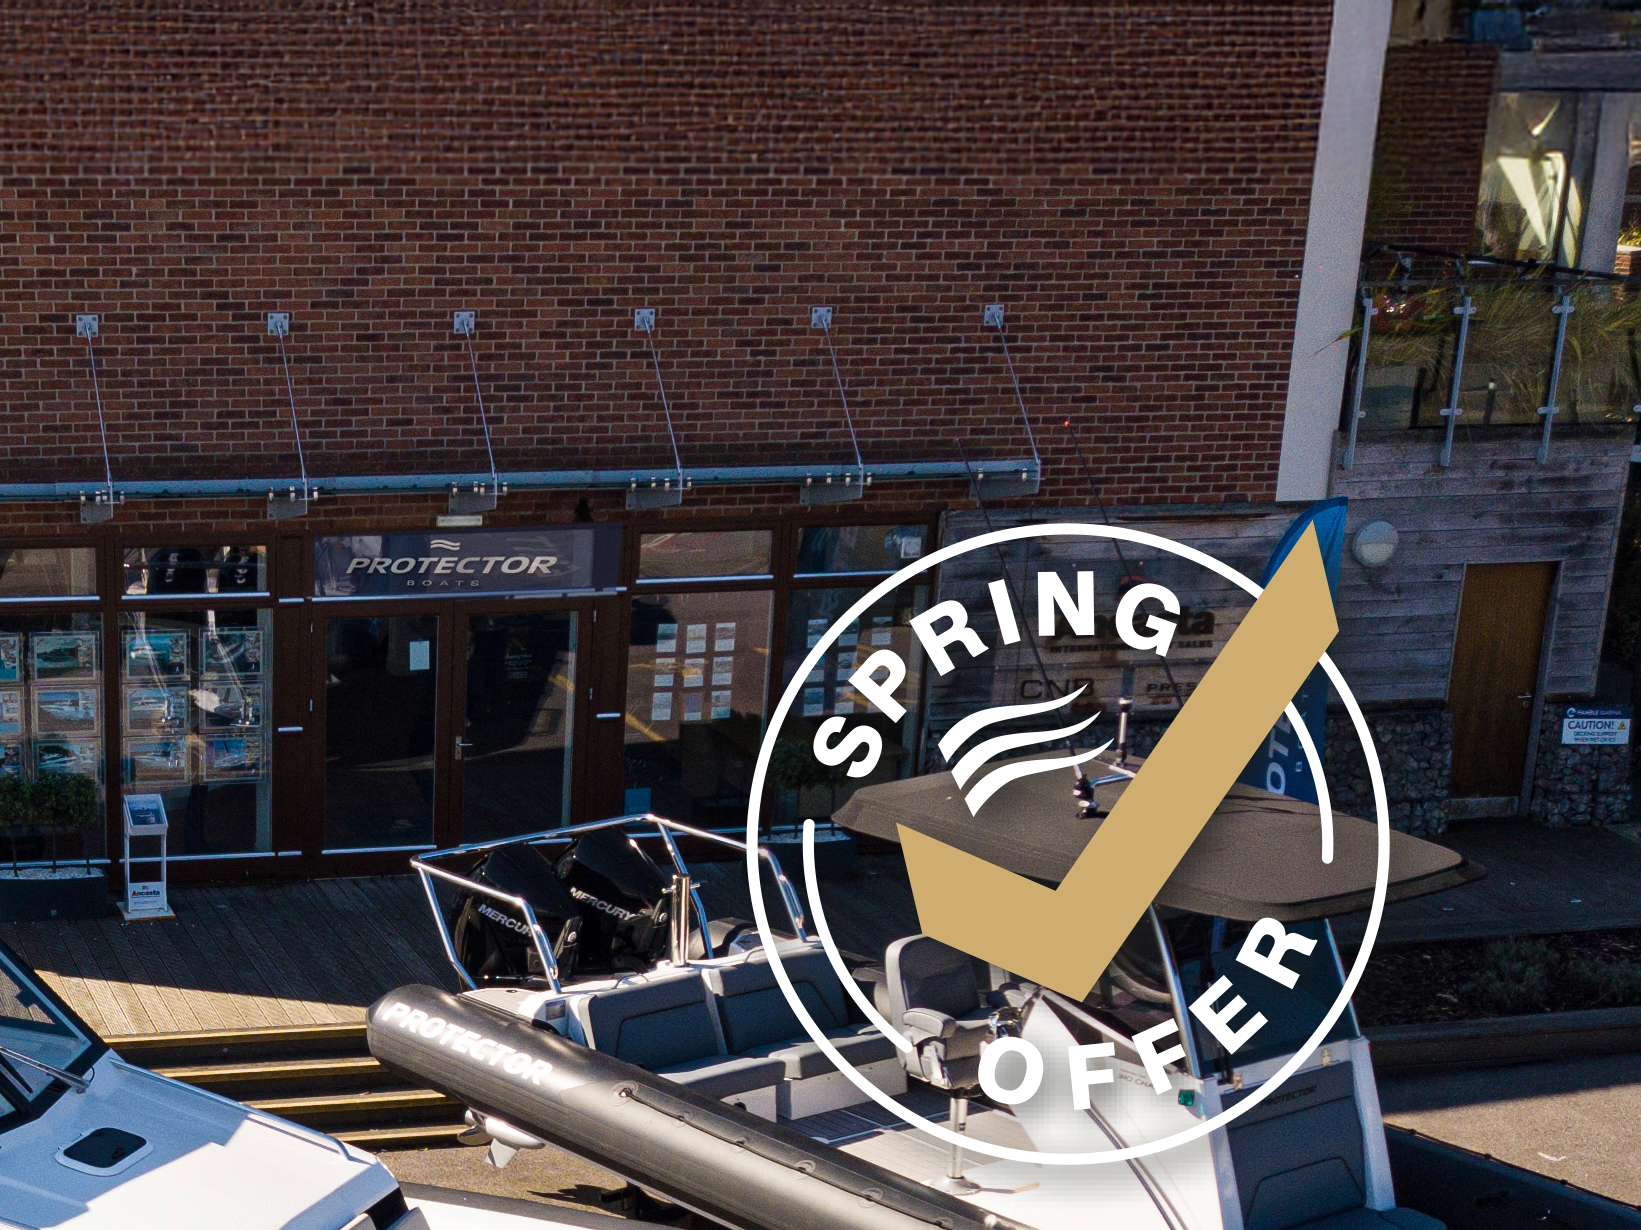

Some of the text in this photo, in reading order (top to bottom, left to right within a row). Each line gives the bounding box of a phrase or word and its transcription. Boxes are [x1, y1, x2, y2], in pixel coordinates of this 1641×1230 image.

[345, 555, 558, 574] PROTECTOR
[406, 579, 480, 587] BOATS
[1567, 720, 1614, 730] CAUTION!
[570, 886, 637, 921] MERCURY
[477, 903, 534, 938] MERCUR
[381, 1002, 553, 1085] PROTECTOR
